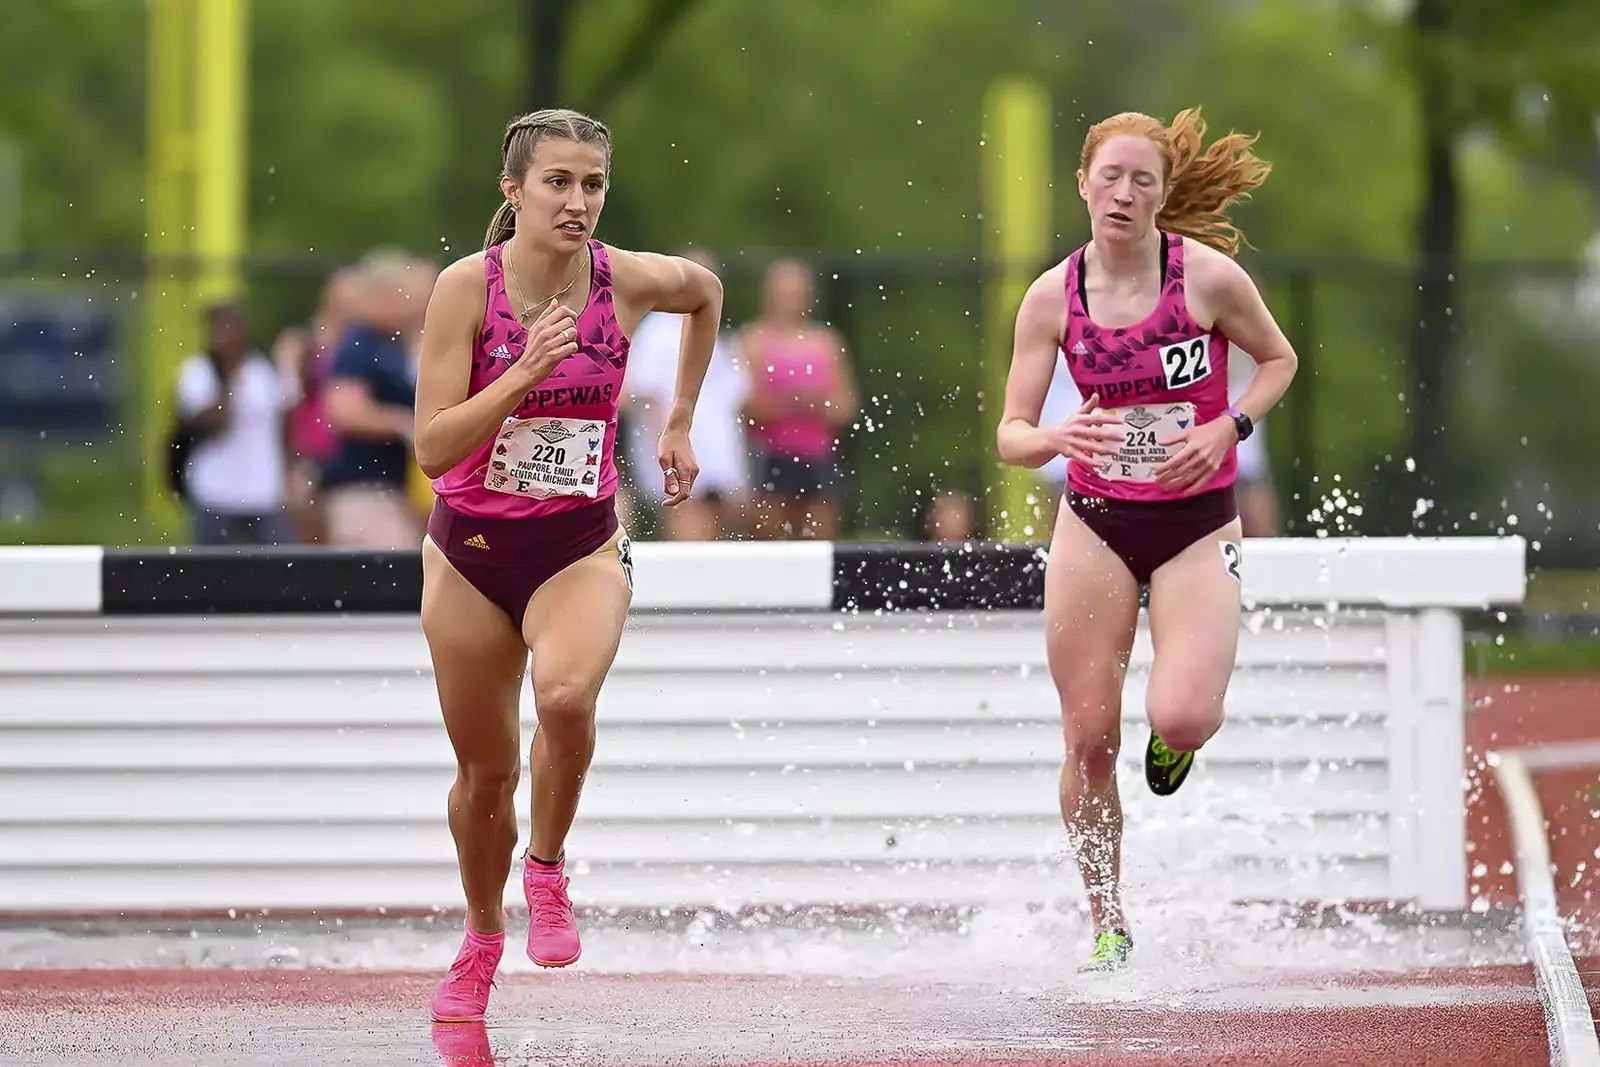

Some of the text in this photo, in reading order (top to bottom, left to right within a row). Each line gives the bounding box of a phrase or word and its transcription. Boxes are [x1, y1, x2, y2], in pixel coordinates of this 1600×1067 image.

[1166, 339, 1208, 387] 22
[516, 383, 613, 410] PPEWAS
[1126, 431, 1156, 447] 224
[531, 444, 566, 465] 220
[1140, 455, 1173, 464] MICHIGA
[509, 468, 541, 482] CENTRAL
[542, 473, 579, 487] MICHIGAN
[553, 466, 575, 477] EMILY
[1121, 464, 1132, 477] E
[516, 480, 530, 494] E
